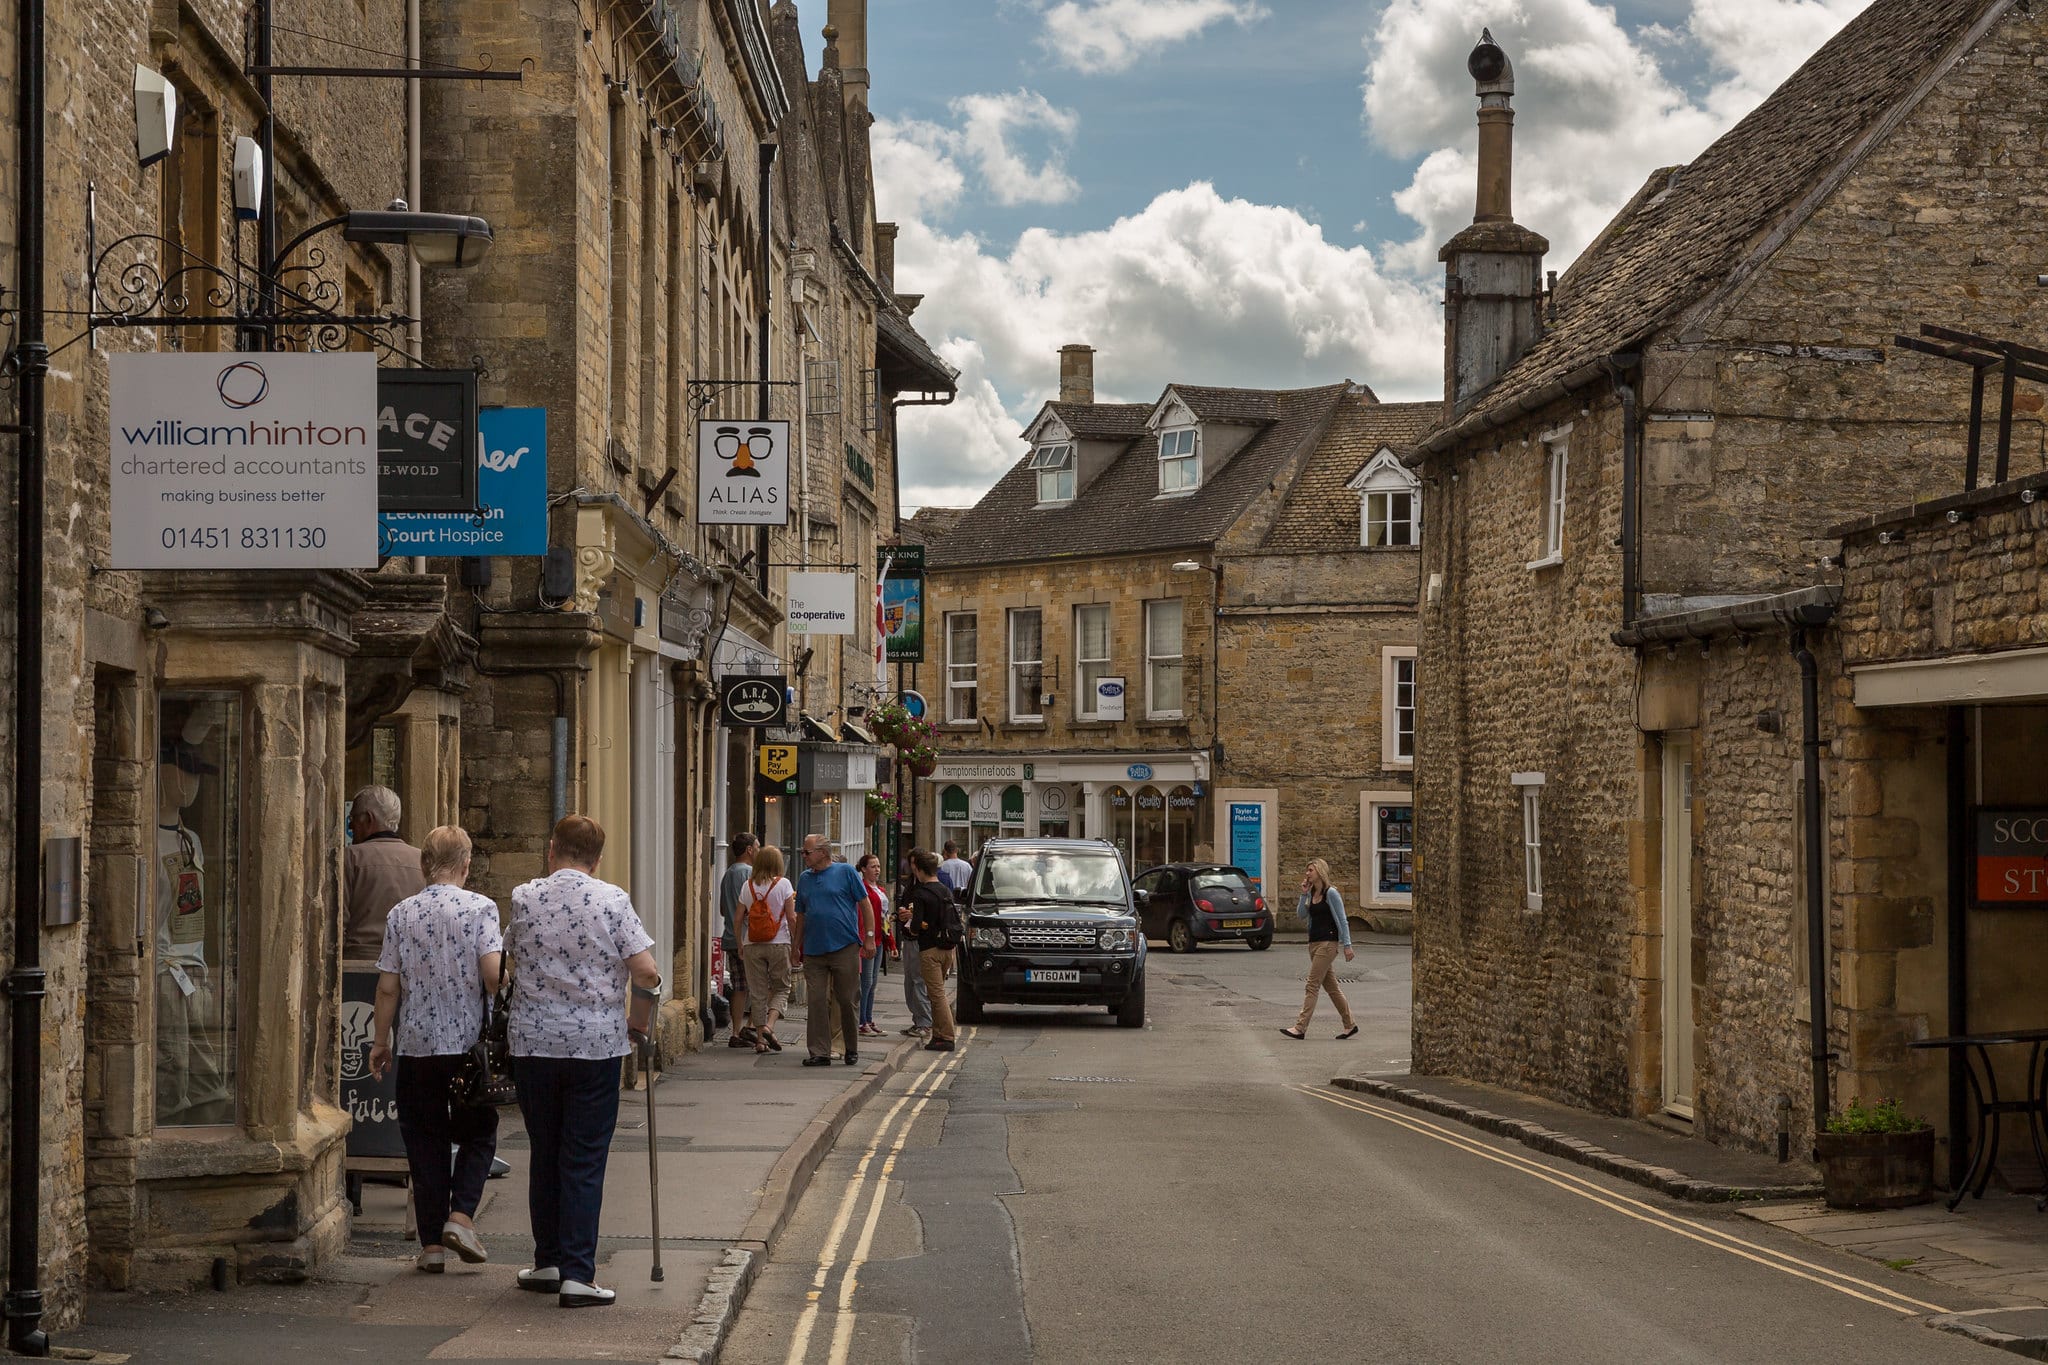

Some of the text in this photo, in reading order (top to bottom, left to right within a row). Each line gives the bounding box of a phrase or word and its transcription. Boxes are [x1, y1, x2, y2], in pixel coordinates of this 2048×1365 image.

[121, 420, 366, 446] williamhinton
[121, 454, 366, 475] chartered accountants
[161, 490, 326, 504] making business better
[709, 486, 778, 504] ALIAS
[162, 527, 327, 549] 01451 831130
[387, 528, 504, 545] Court Hospice
[898, 551, 919, 559] KING
[790, 599, 805, 609] The
[790, 611, 846, 621] co-operative
[790, 621, 808, 631] food
[768, 761, 782, 770] Pay
[1138, 795, 1162, 808] Quality
[2004, 869, 2048, 894] ST
